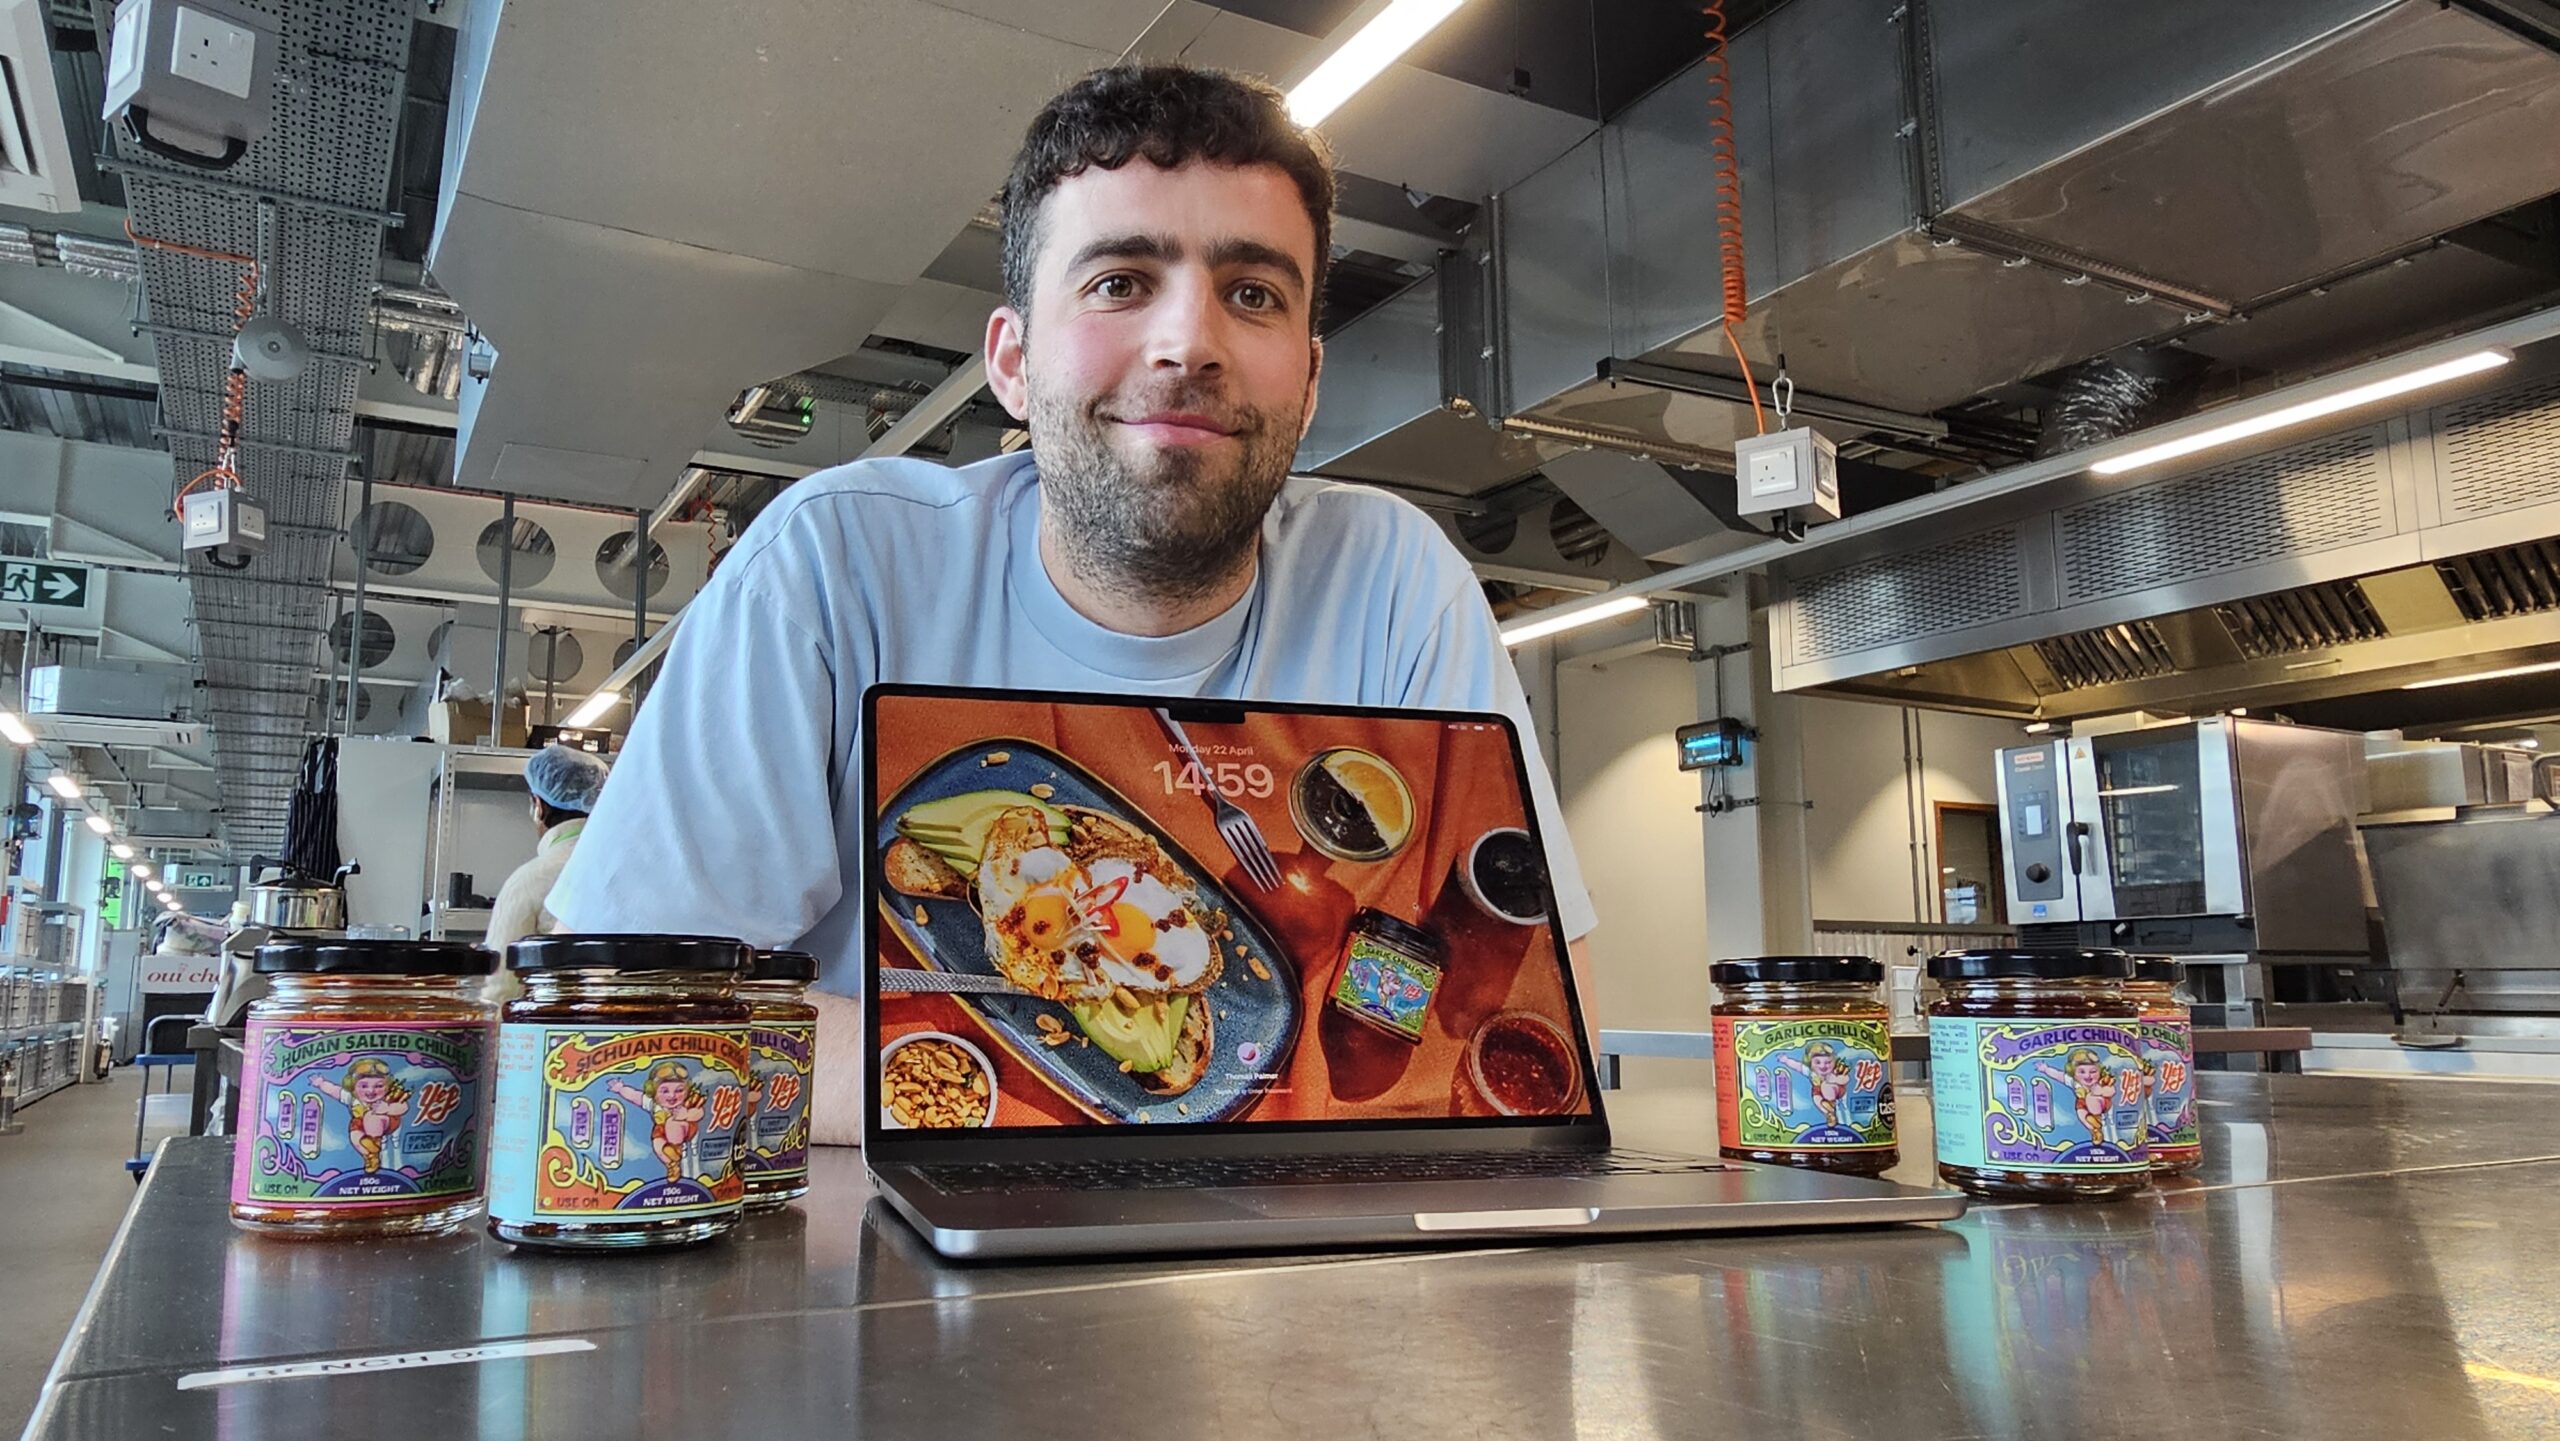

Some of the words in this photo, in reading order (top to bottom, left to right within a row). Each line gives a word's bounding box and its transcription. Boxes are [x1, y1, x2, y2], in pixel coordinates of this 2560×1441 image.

[1212, 744, 1227, 755] 22
[1229, 745, 1254, 756] April
[1153, 761, 1274, 798] 14:59
[1764, 1025, 1814, 1044] GARLIC
[1818, 1024, 1857, 1037] CHILLI
[1860, 1029, 1876, 1044] OIL
[2019, 1029, 2077, 1051] GARLIC
[2081, 1028, 2122, 1043] CHILLI
[281, 1037, 340, 1069] HUNAN
[345, 1034, 410, 1050] SALTED
[576, 1038, 663, 1069] SICHUAN
[668, 1036, 717, 1052] CHILLI
[781, 1038, 798, 1056] OIL
[338, 1186, 359, 1195] NET
[362, 1184, 400, 1195] WEIGHT
[642, 1197, 662, 1206] NET
[664, 1194, 700, 1205] WEIGHT
